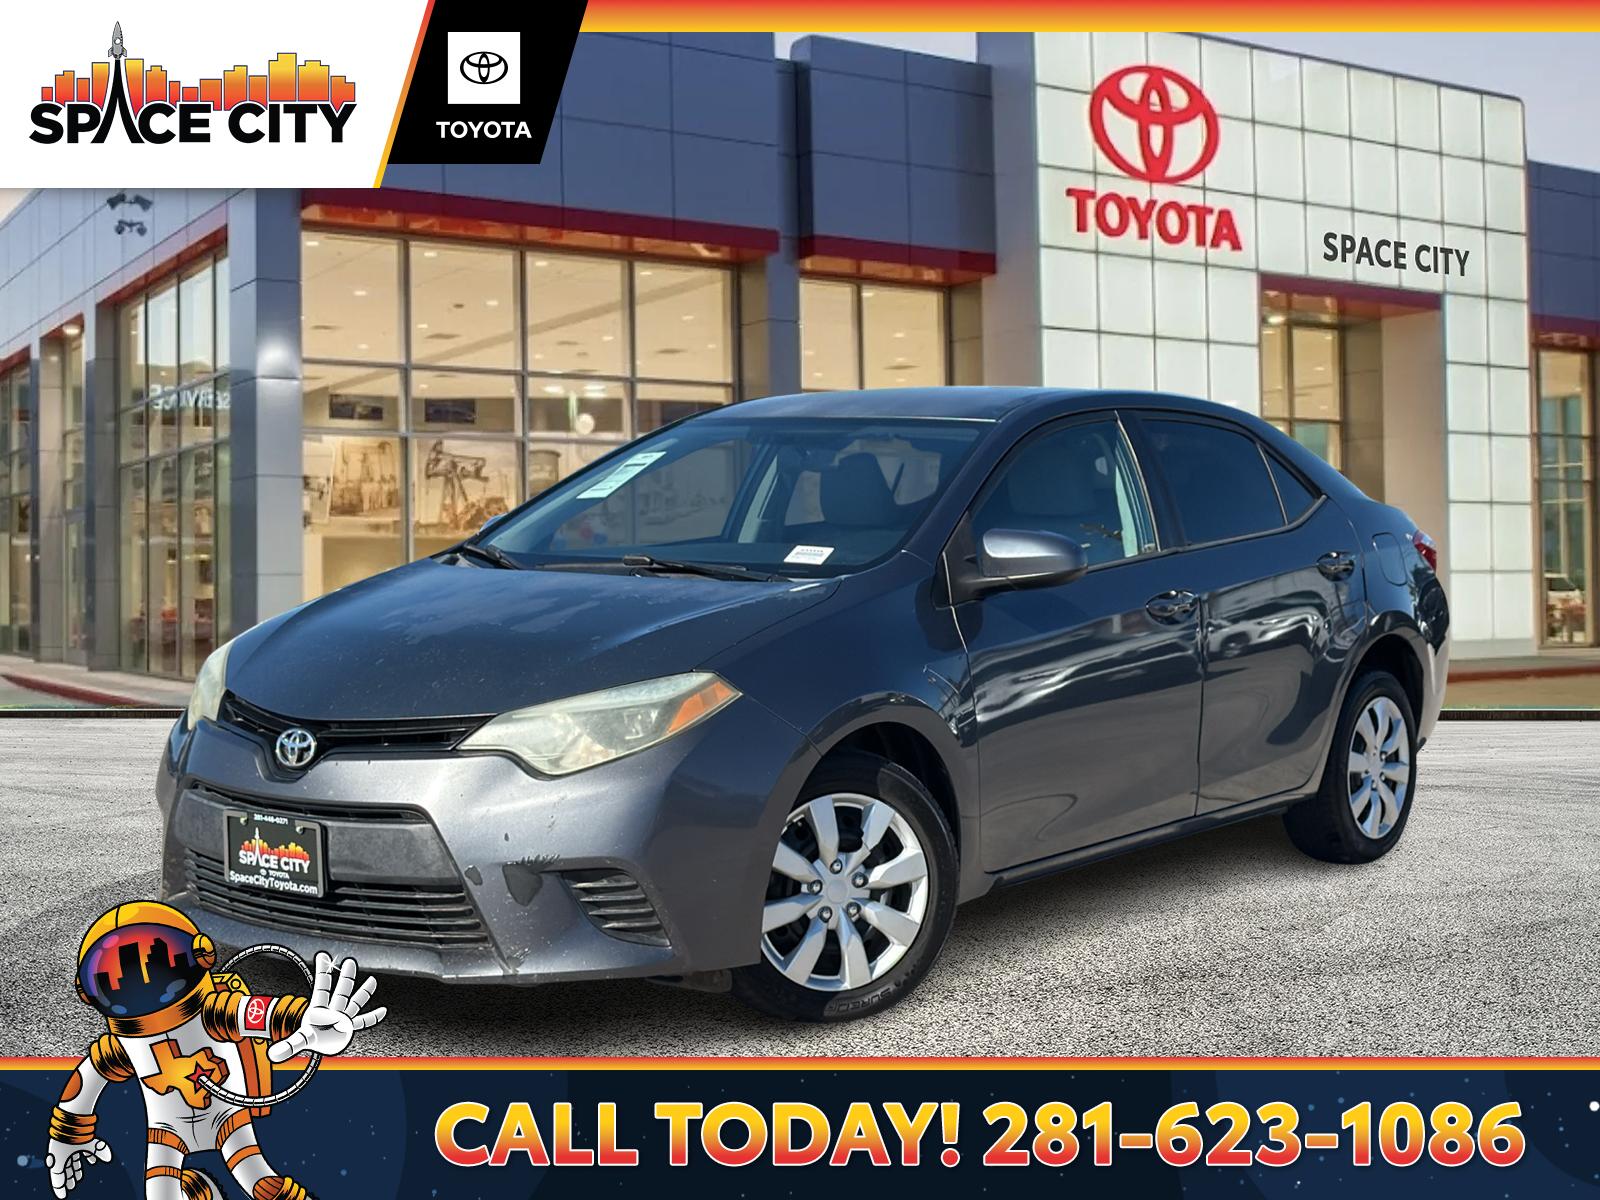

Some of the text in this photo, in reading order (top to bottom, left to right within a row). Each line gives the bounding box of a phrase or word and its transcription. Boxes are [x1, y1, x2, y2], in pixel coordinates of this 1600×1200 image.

[1066, 187, 1243, 251] TOYOTA
[1323, 231, 1470, 277] SPACE CITY
[238, 849, 311, 874] SPACE CITY
[268, 869, 290, 879] TOYOTA
[229, 870, 318, 895] SpaceCityToyota.com
